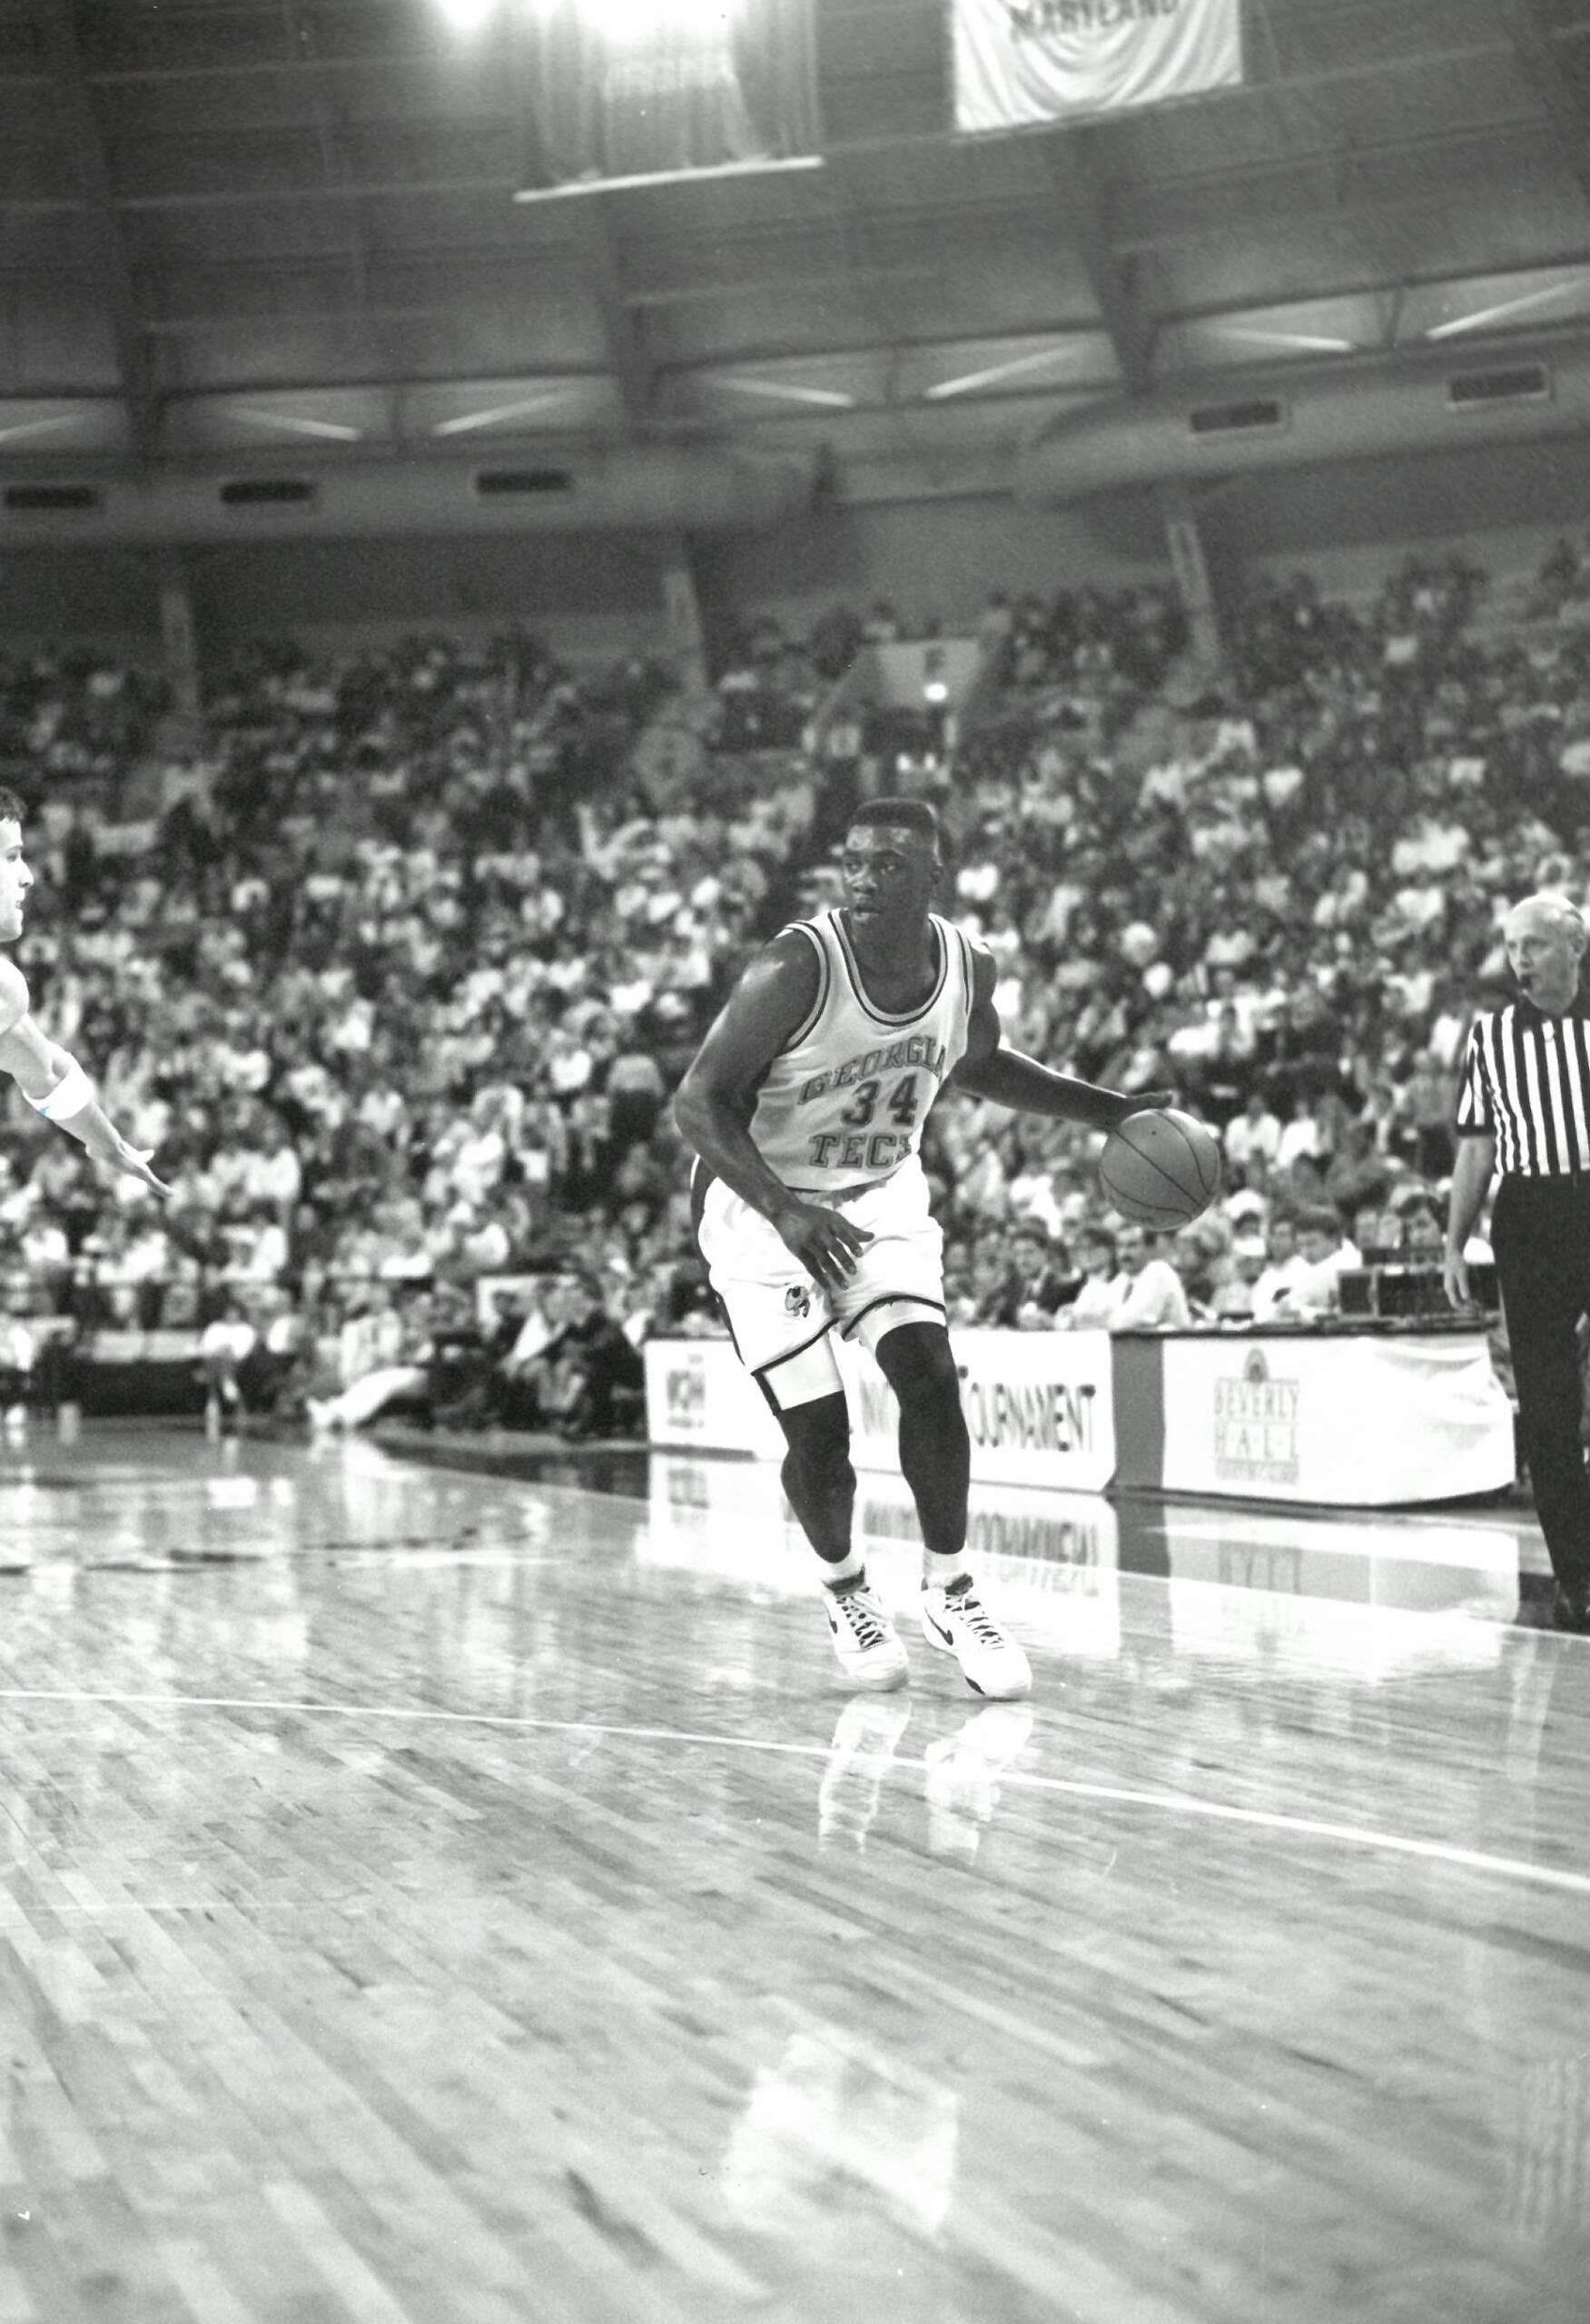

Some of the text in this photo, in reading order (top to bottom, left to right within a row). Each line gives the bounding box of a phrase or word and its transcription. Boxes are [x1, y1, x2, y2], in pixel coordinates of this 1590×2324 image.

[798, 1035, 946, 1105] GEORGIA
[841, 1074, 917, 1127] 34
[956, 1364, 1094, 1452] OURNAMENT
[1214, 1383, 1300, 1418] BEVERLY
